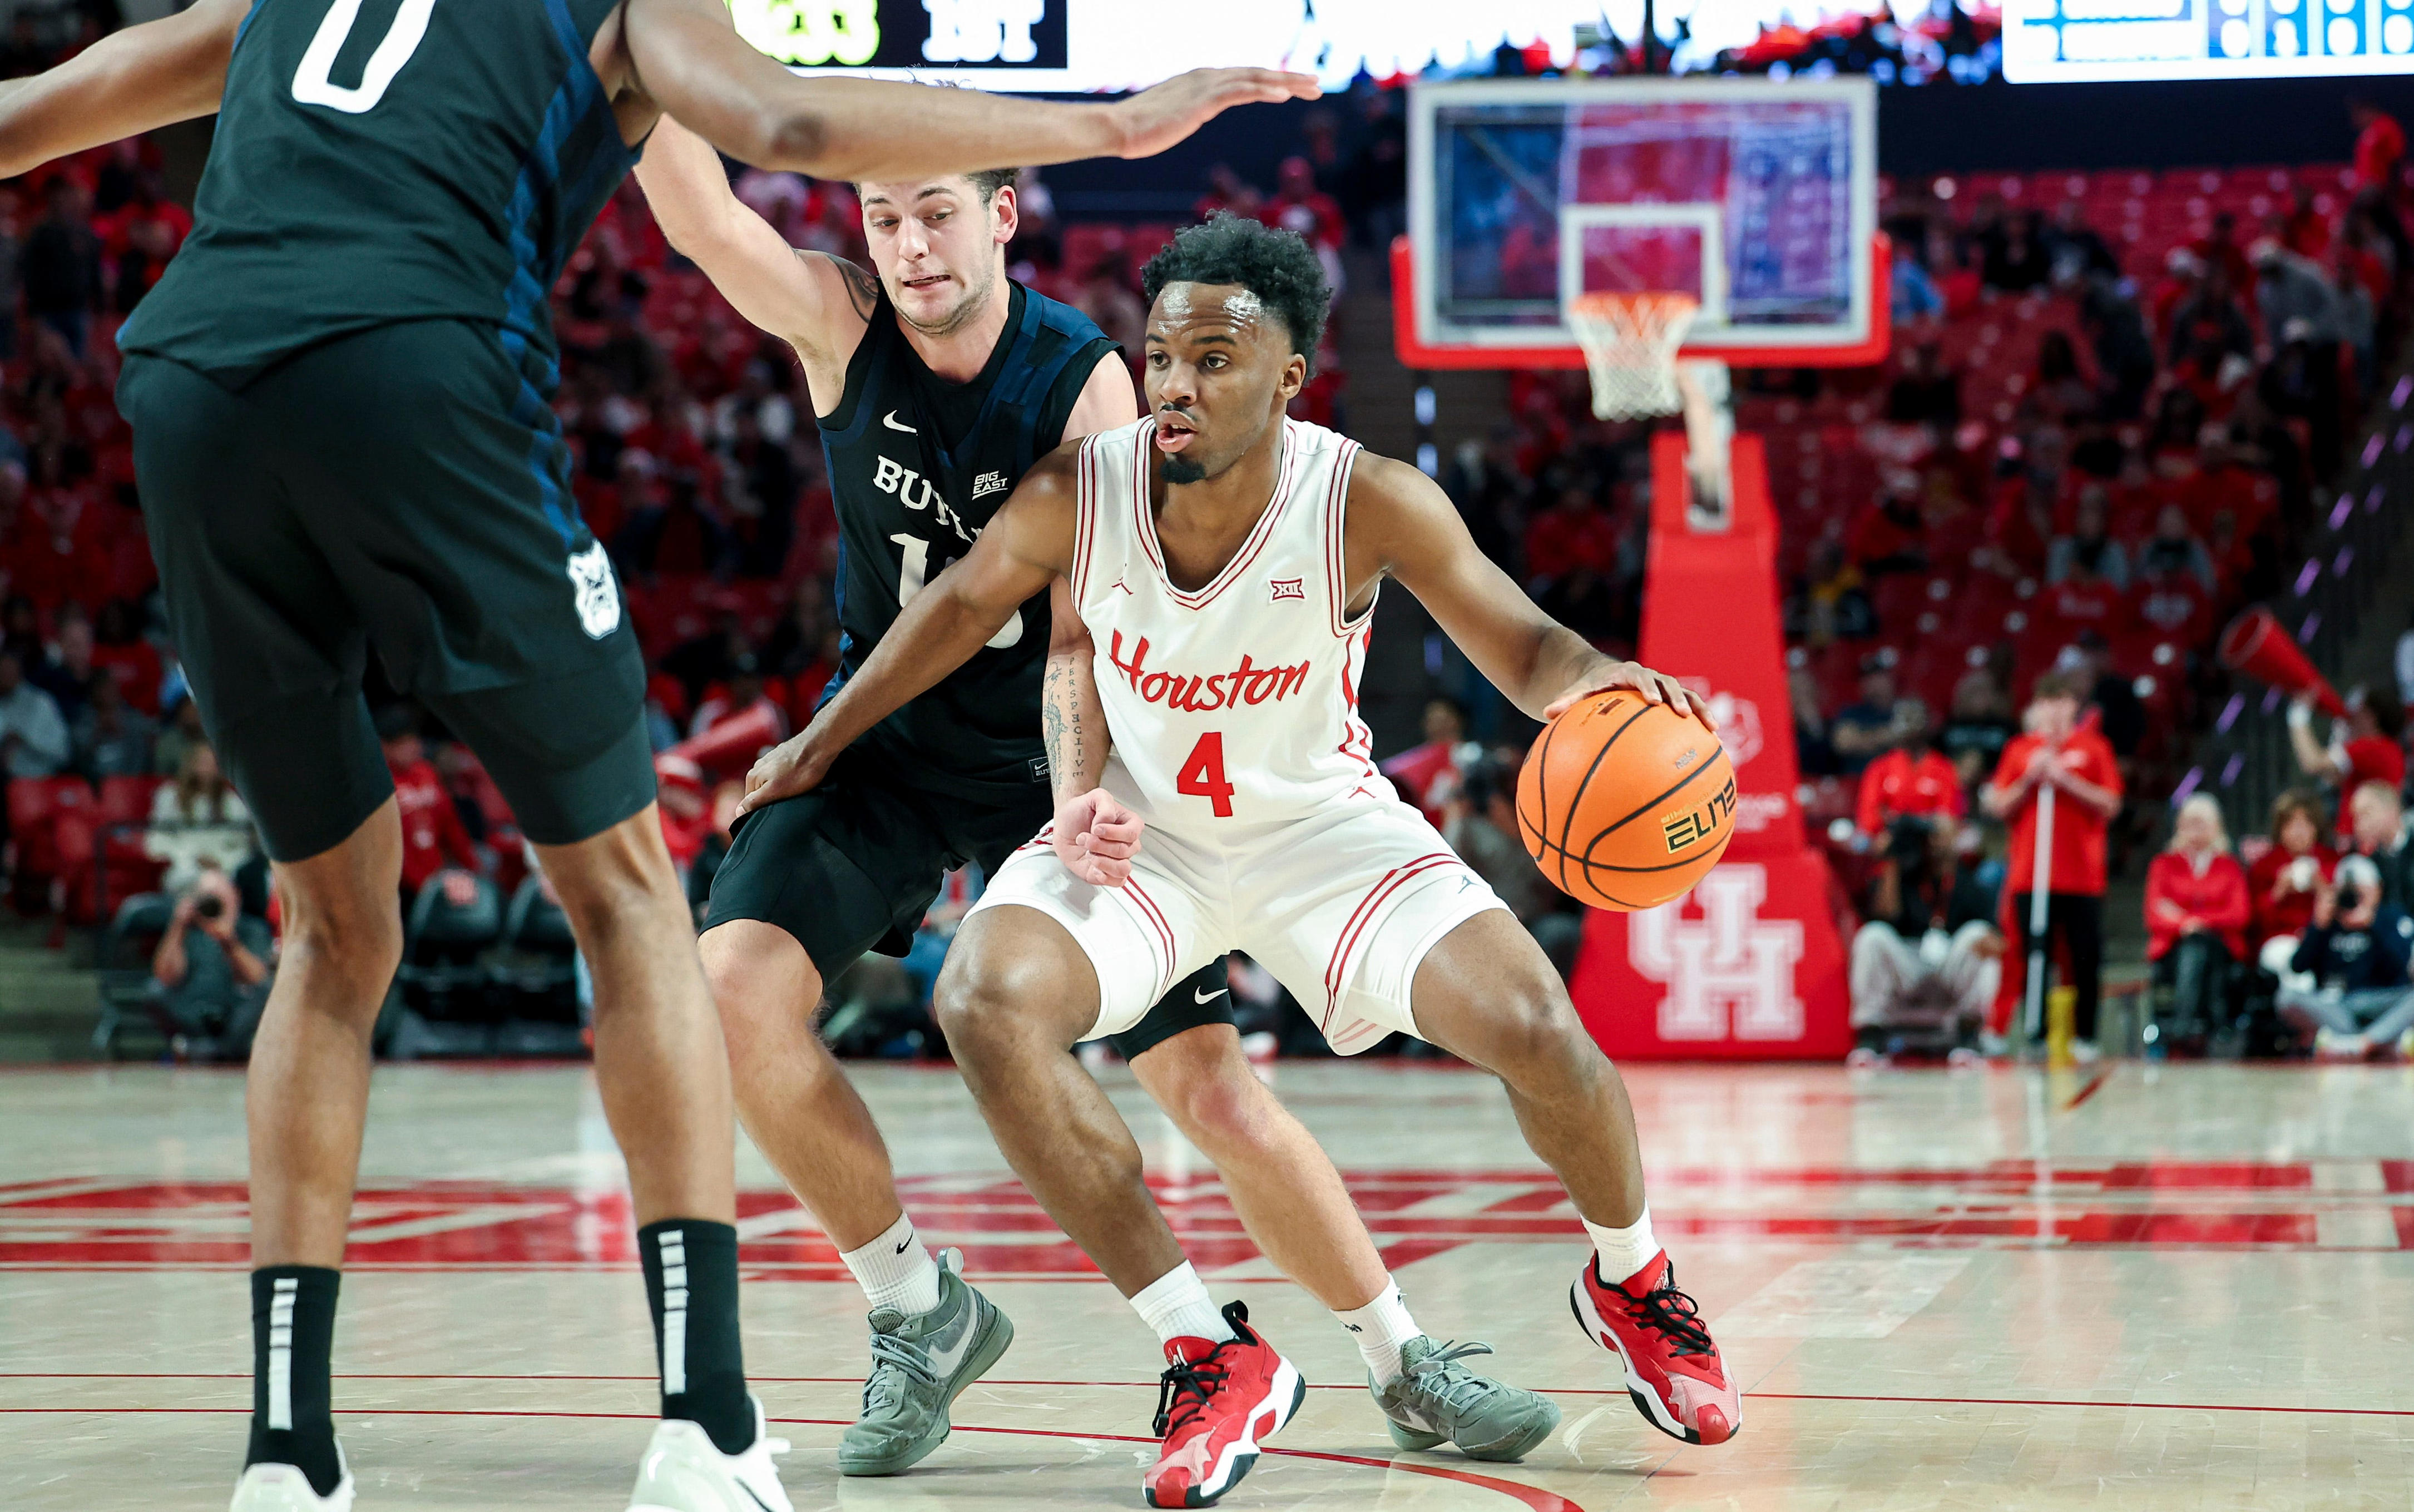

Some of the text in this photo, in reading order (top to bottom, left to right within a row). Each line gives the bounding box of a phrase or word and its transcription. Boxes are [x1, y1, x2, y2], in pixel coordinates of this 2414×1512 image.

[972, 478, 1008, 494] EAST
[974, 470, 1000, 485] BIG
[1110, 628, 1310, 712] Houston
[1069, 657, 1084, 777] PERSPECTIVE
[1176, 732, 1234, 817] 4
[1664, 776, 1737, 853] ELITE
[1628, 862, 1805, 1041] UH
